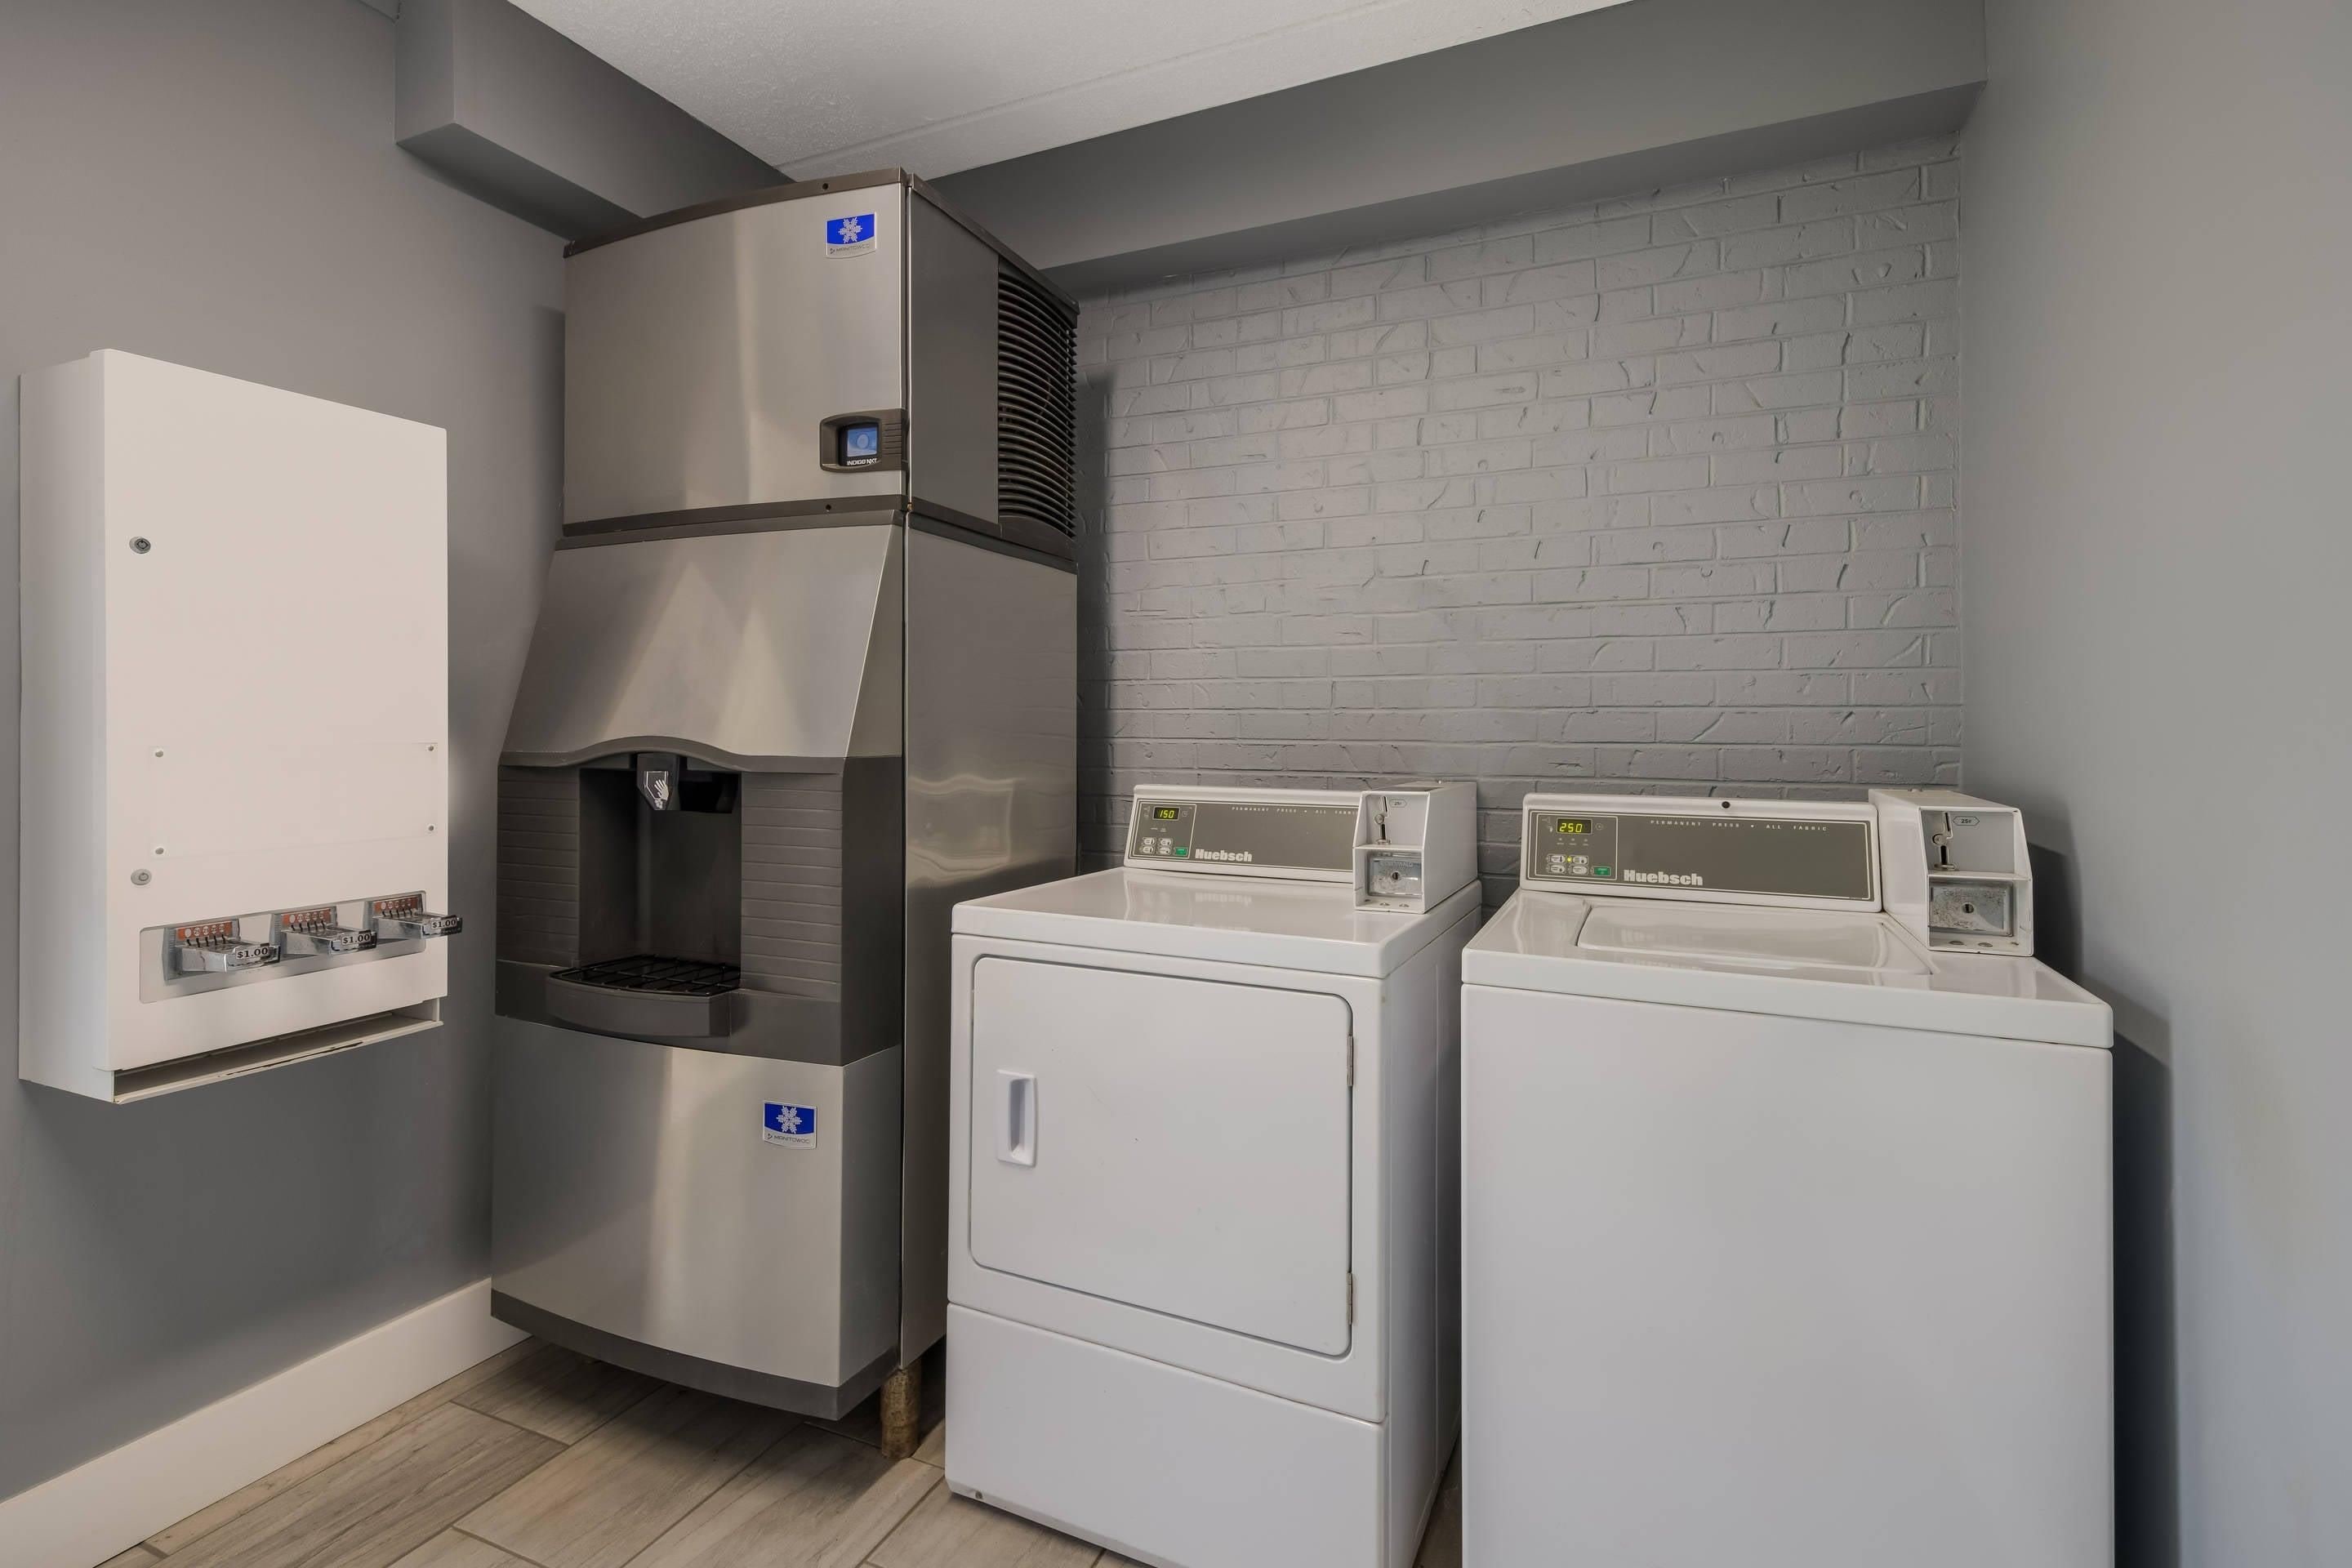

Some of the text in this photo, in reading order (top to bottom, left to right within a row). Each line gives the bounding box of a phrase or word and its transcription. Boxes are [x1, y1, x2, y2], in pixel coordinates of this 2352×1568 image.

[1159, 808, 1175, 819] 150
[1559, 822, 1583, 833] 250
[1195, 849, 1253, 862] Huebsch
[1624, 869, 1703, 886] Huebsch
[432, 918, 457, 929] $1.00
[342, 933, 371, 945] $1.00
[237, 947, 269, 960] $1.00
[773, 1134, 810, 1144] MANITOWOC
